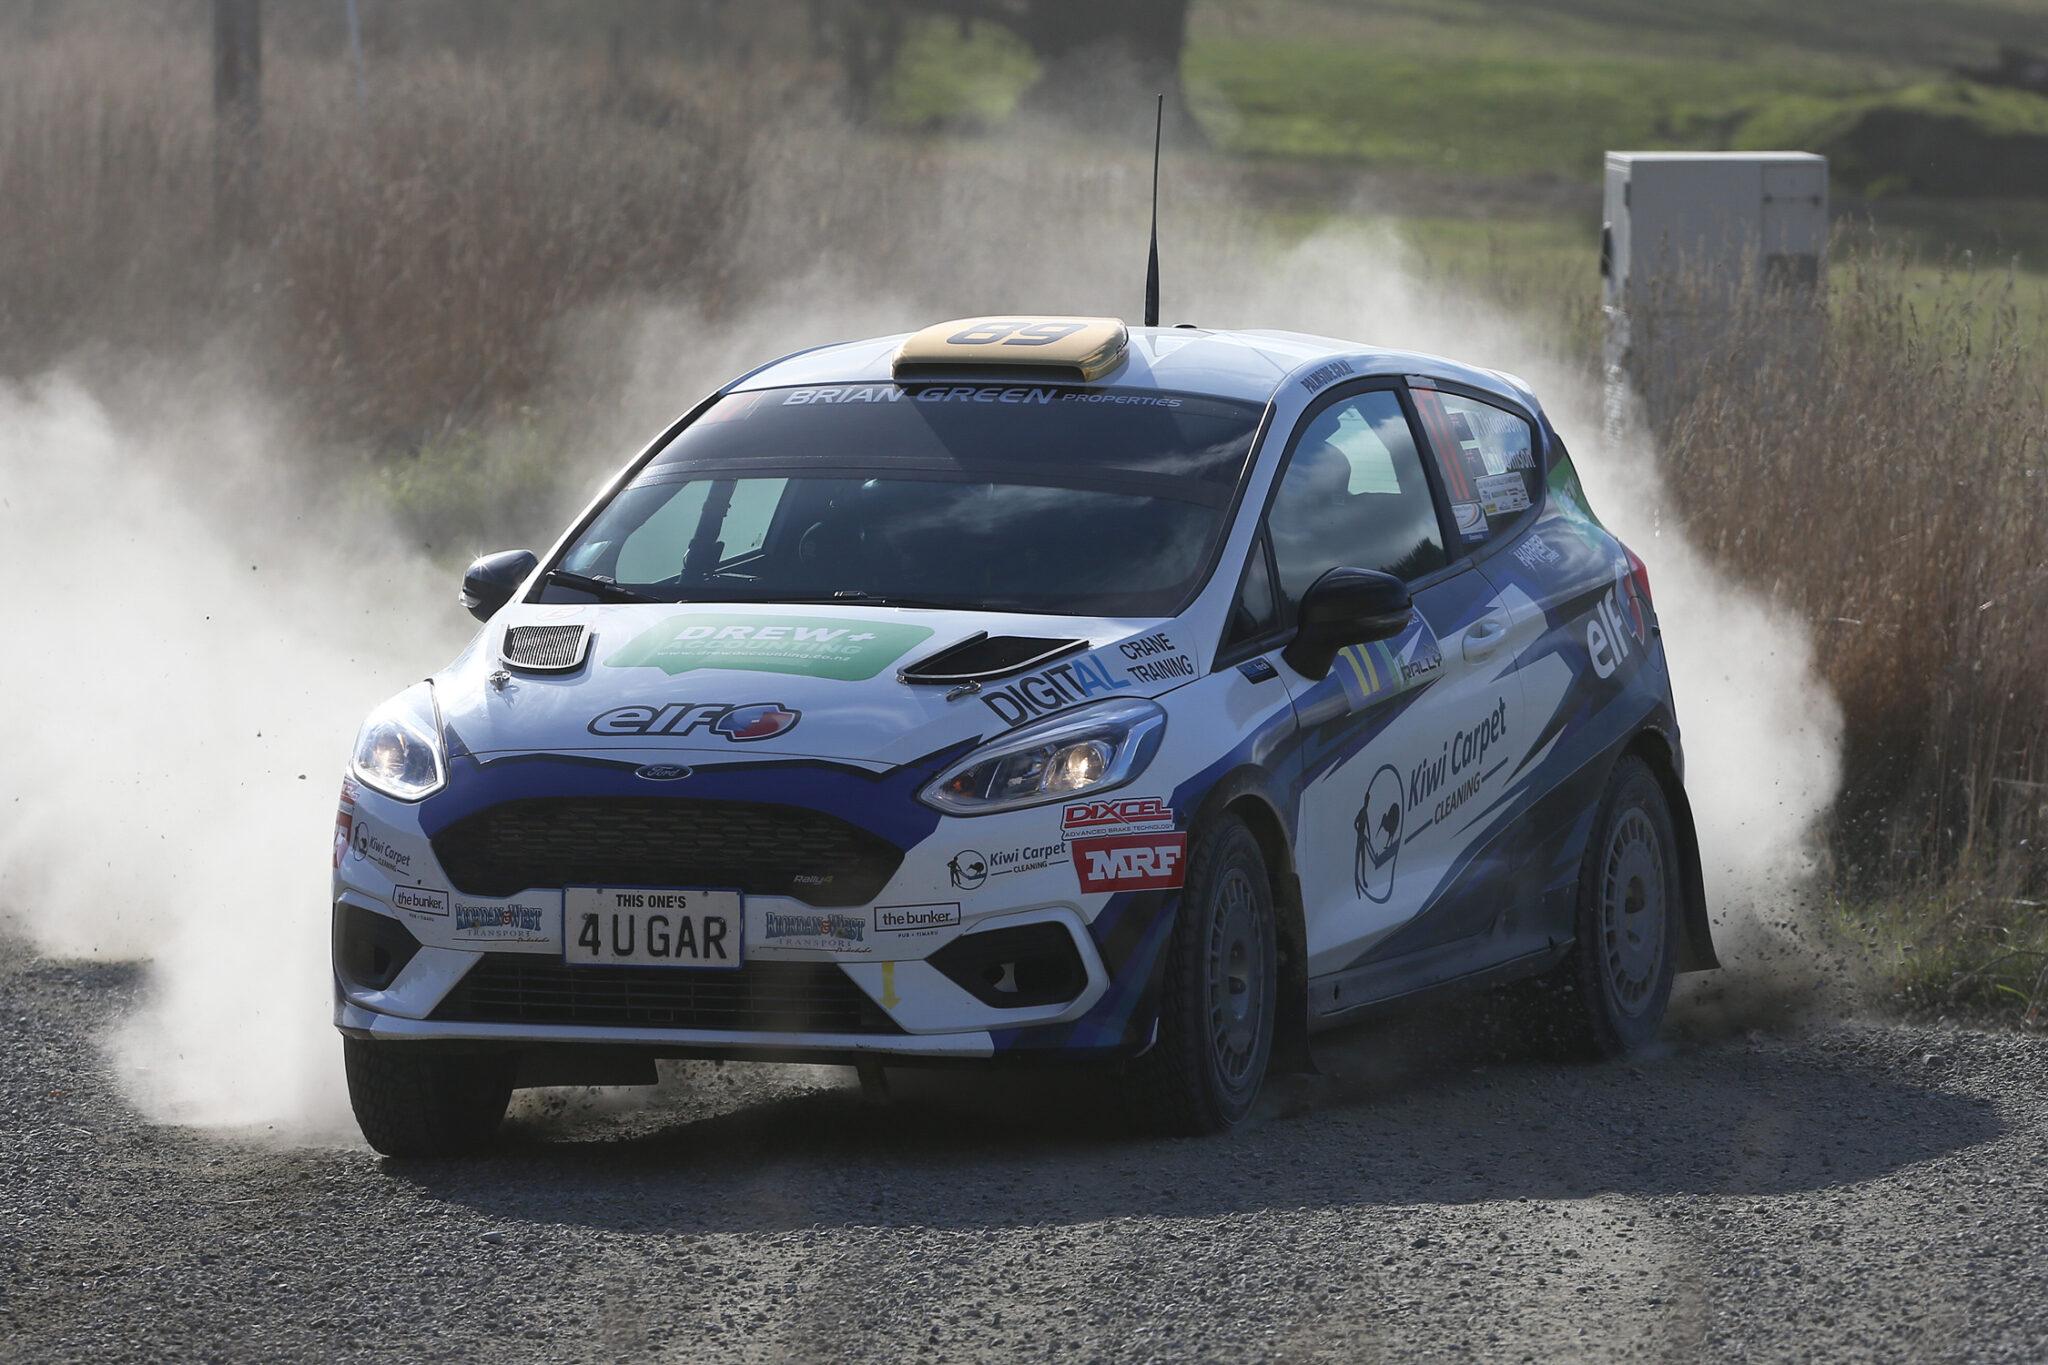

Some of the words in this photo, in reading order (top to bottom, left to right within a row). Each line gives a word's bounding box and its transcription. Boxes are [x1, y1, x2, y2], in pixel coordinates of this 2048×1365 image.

[946, 322, 1088, 346] 89
[782, 387, 905, 406] BRIAN
[916, 387, 1057, 405] GREEN
[1061, 393, 1184, 407] PROPERTIES
[1587, 586, 1629, 679] elf
[664, 640, 864, 654] ACCOUNTING
[1119, 633, 1177, 661] CRANE
[1126, 654, 1196, 684] TRAINING
[979, 653, 1132, 728] DIGITAL
[586, 703, 737, 736] elf
[1407, 741, 1449, 812] Kiwi
[1451, 696, 1507, 776] Carpet
[1434, 771, 1481, 825] CLEANING
[1065, 800, 1172, 823] DIXCEL
[1064, 828, 1107, 838] ADVANCED
[1107, 825, 1131, 834] BRAKE
[1132, 823, 1174, 832] TECHNOLOGY
[369, 835, 384, 854] Kiwi
[384, 844, 411, 867] Carpet
[990, 849, 1019, 866] Kiwi
[1022, 841, 1067, 862] Carpet
[1085, 845, 1182, 881] MRF
[1013, 861, 1048, 874] CLEANING
[397, 891, 412, 906] the
[412, 892, 445, 911] bunker.
[616, 894, 644, 908] THIS
[647, 894, 687, 909] ONE'S
[882, 912, 906, 926] the
[906, 910, 954, 925] bunker.
[467, 929, 532, 938] TRANSPORT
[777, 938, 852, 949] TRANSPORT
